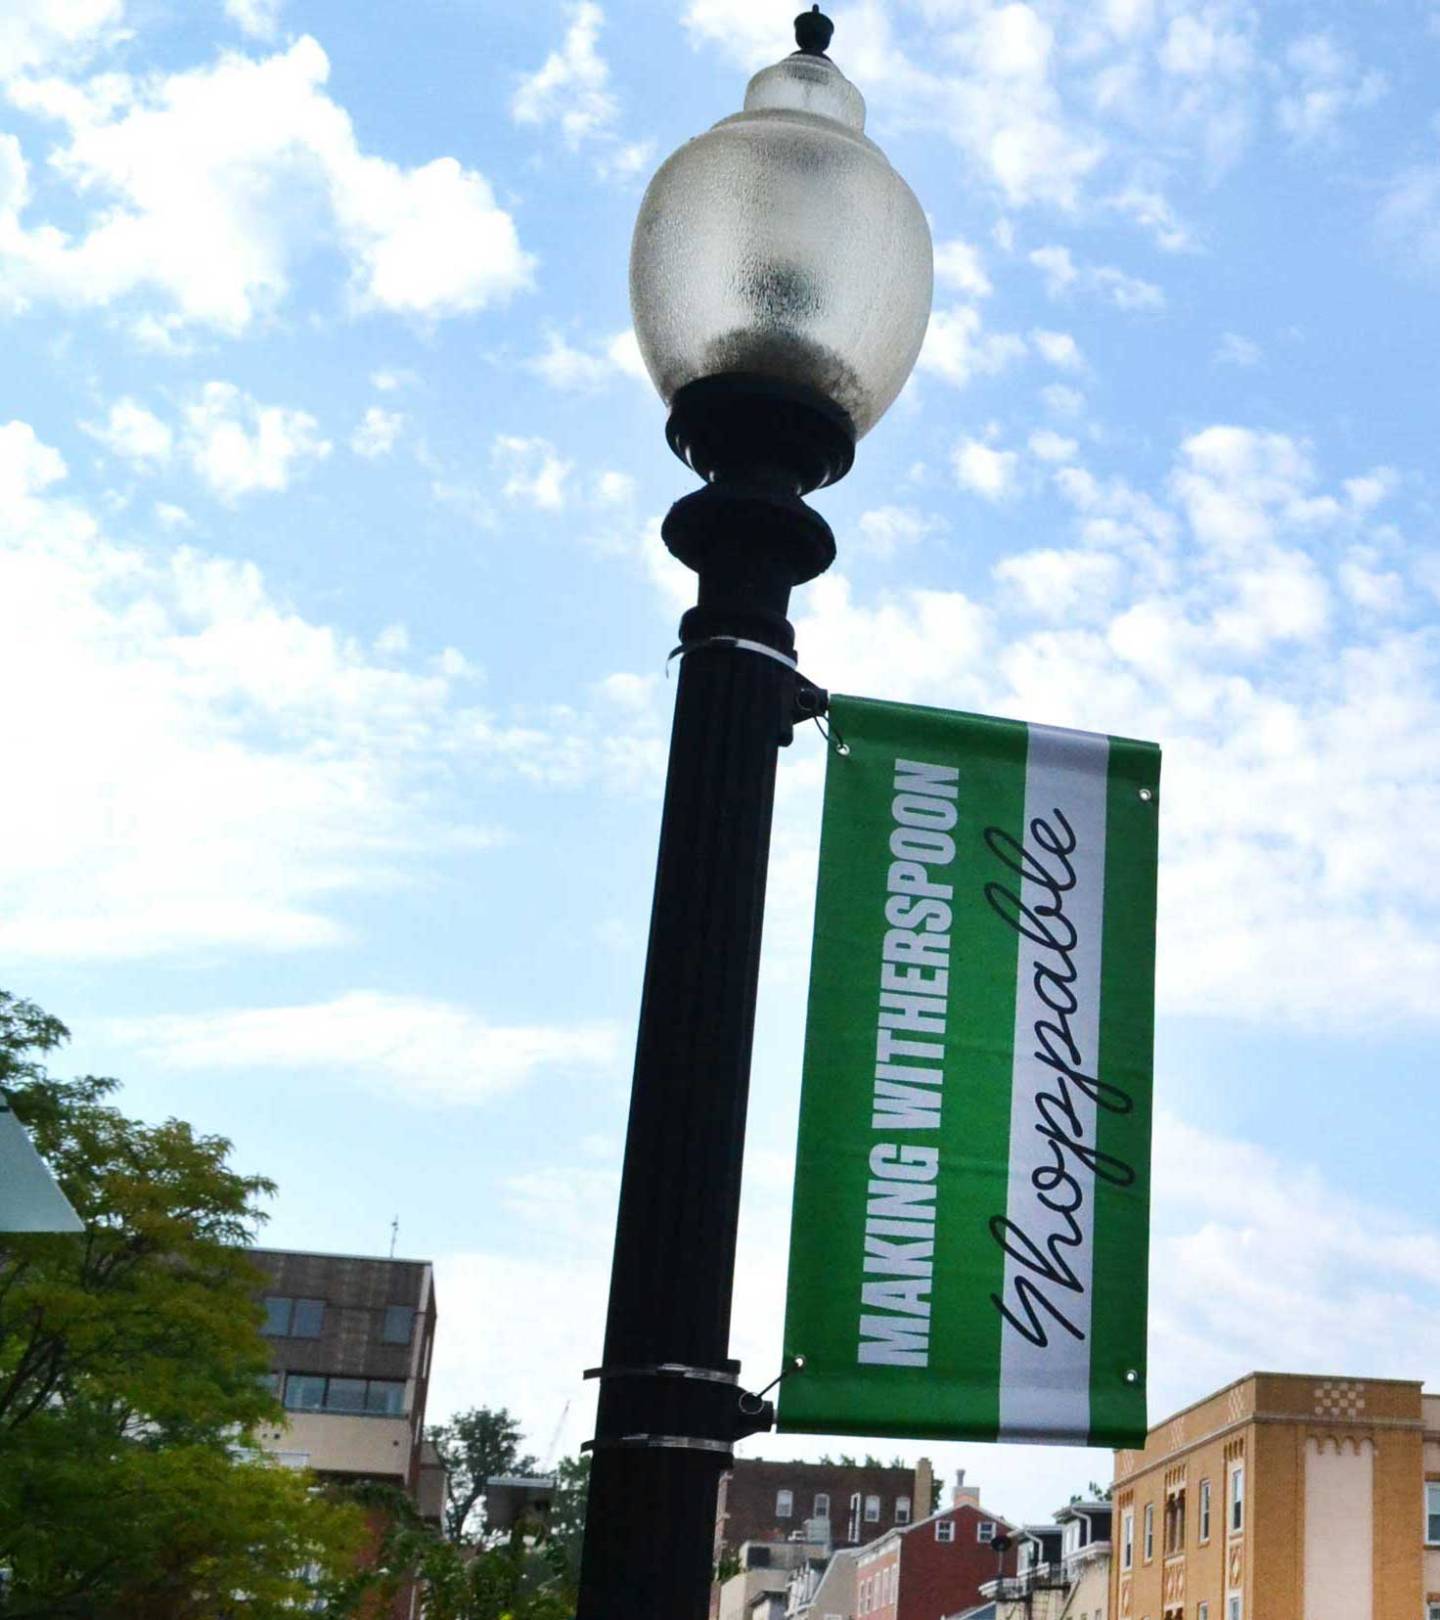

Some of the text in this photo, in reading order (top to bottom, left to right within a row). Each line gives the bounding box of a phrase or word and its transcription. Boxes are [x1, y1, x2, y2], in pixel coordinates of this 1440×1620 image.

[857, 758, 960, 1367] MAKING WITHERSPOON
[983, 806, 1137, 1350] Shoppable
